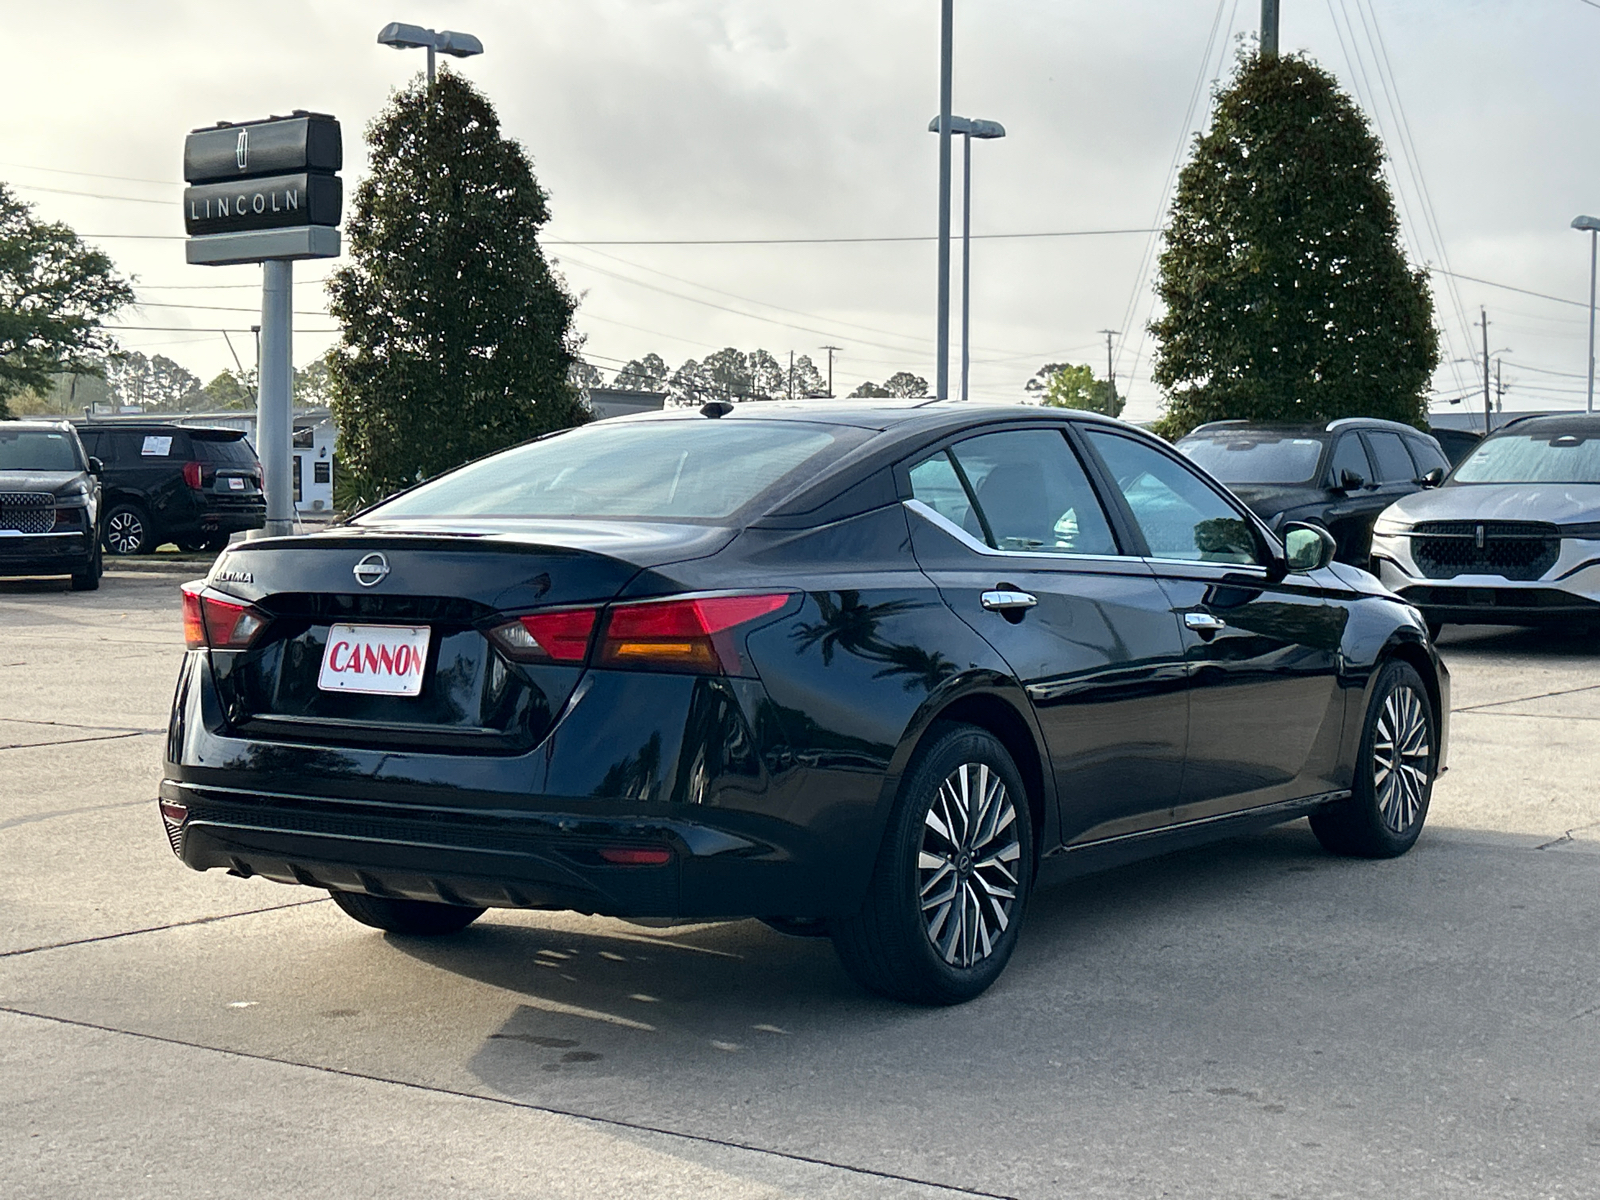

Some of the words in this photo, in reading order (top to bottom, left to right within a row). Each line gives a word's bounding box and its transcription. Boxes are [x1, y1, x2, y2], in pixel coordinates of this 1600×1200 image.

[191, 190, 298, 220] LINCOLN
[215, 571, 253, 584] ALTIMA
[329, 641, 424, 676] CANNON
